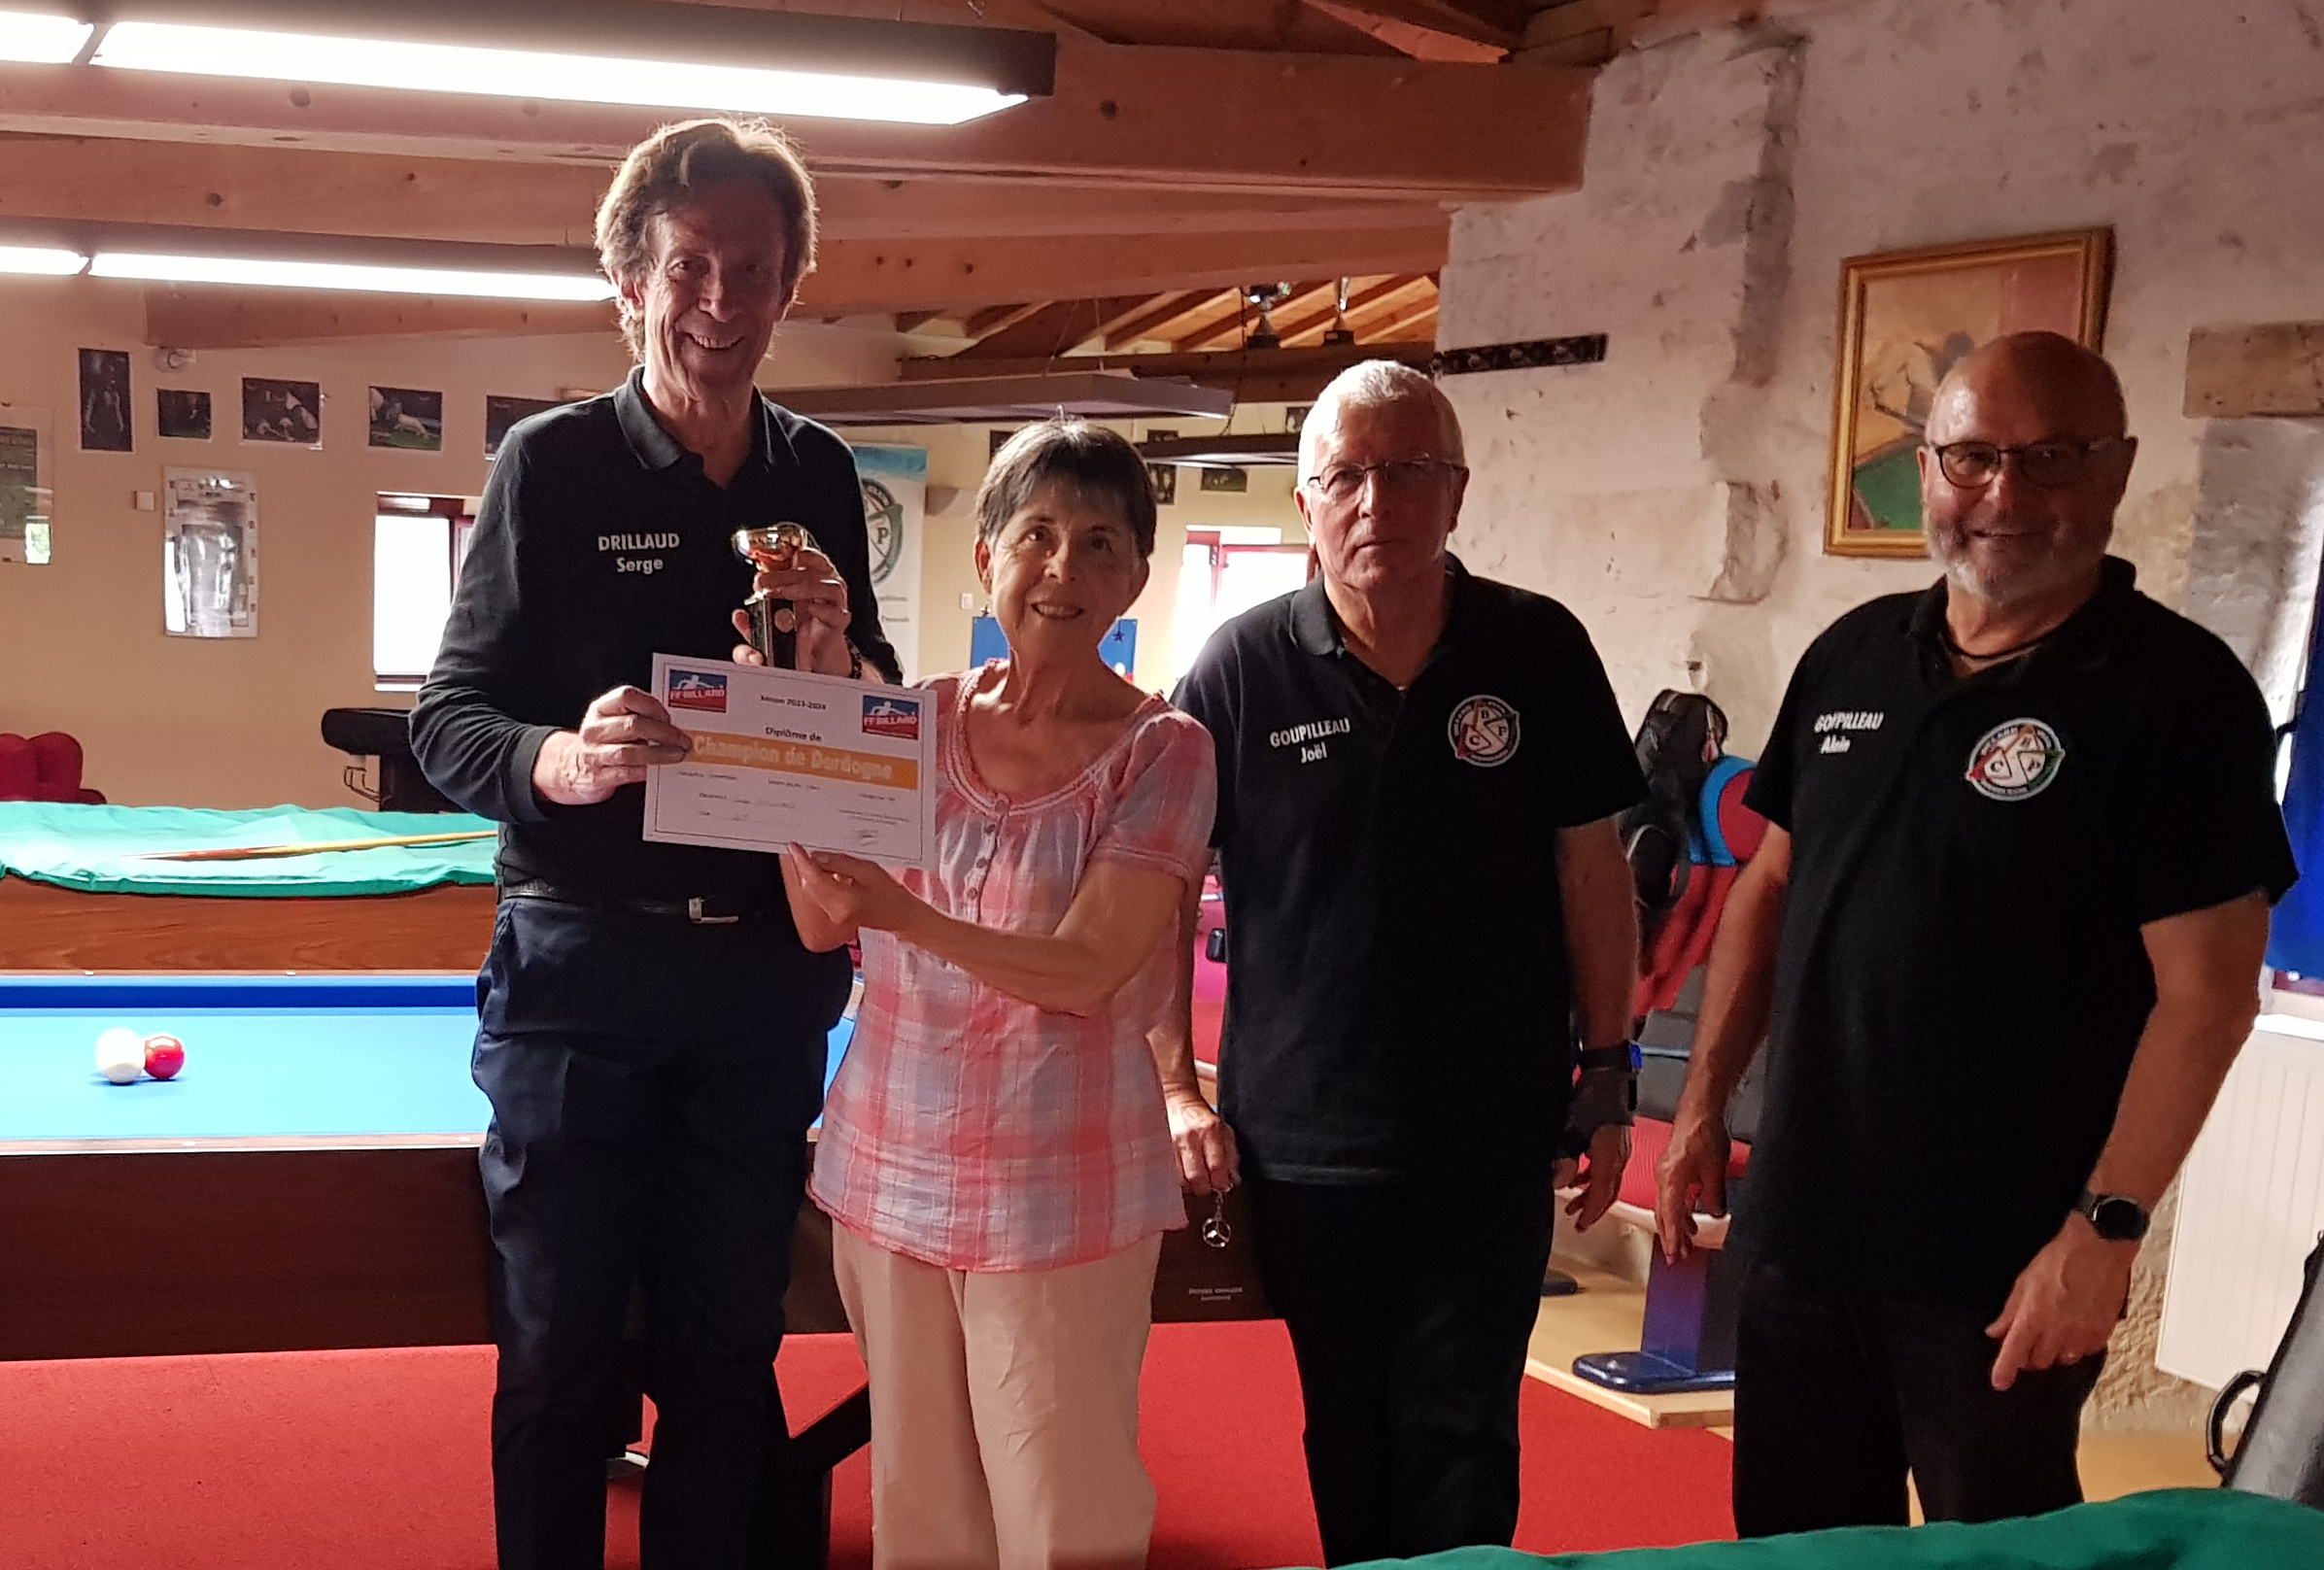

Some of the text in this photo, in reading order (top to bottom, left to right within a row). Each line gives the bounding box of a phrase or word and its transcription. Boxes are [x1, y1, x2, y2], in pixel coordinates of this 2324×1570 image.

[598, 532, 681, 552] DRILLAUD
[616, 557, 665, 575] Serge
[765, 727, 822, 741] Diplôme de
[1269, 717, 1351, 748] GOUPILLEAU
[693, 734, 893, 780] Champion de Dordogne
[1300, 741, 1328, 764] Joël
